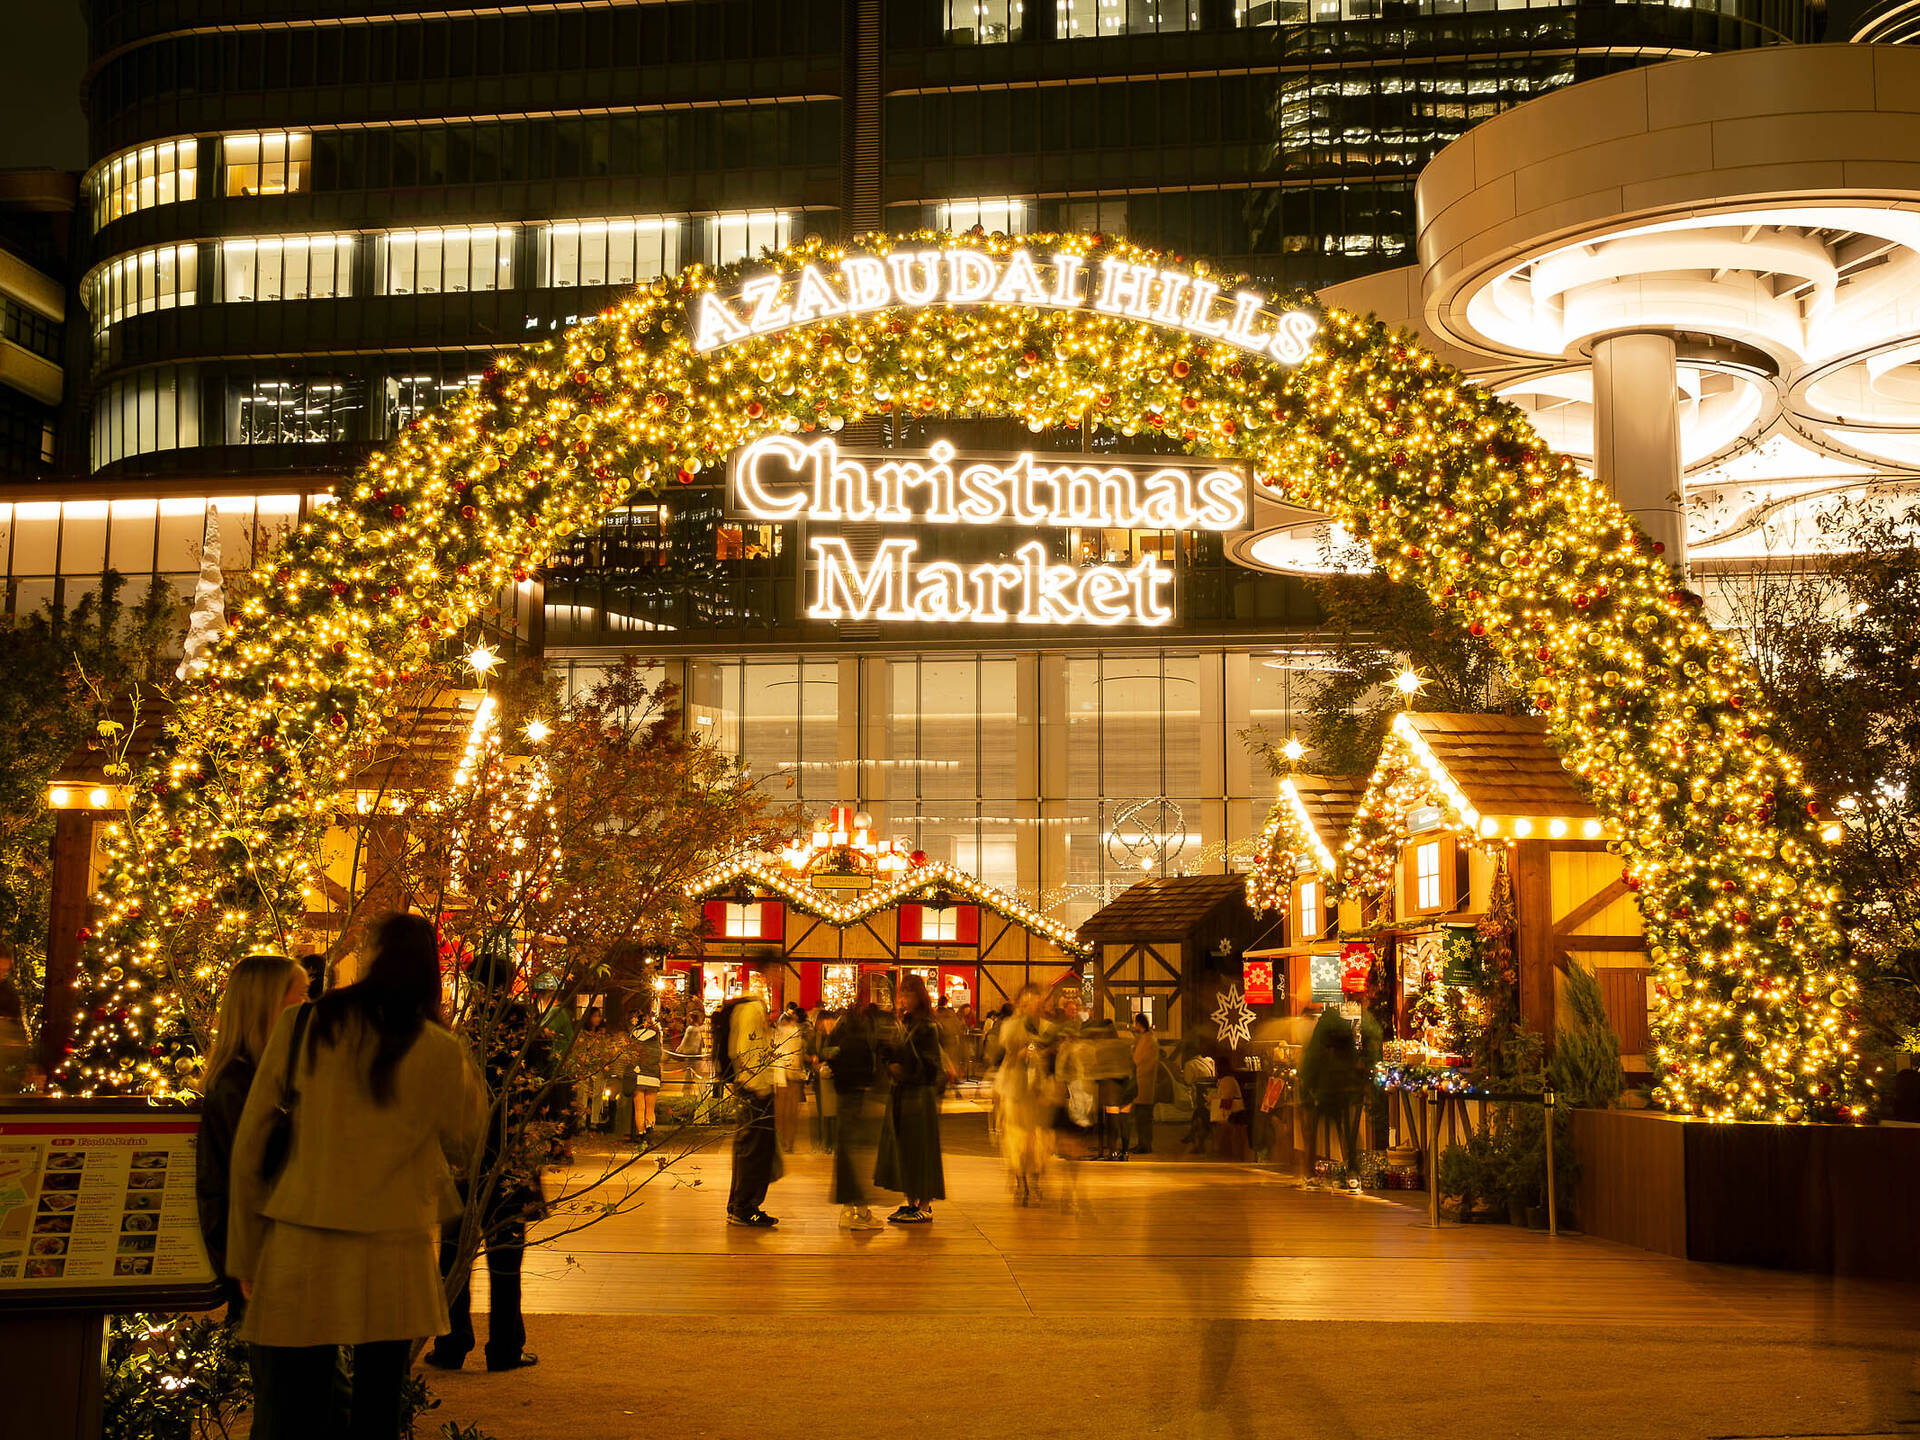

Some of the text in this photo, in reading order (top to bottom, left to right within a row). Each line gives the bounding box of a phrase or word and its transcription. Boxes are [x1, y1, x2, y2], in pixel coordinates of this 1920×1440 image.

[696, 249, 1319, 366] AZABUDAI HILLS
[735, 436, 1247, 530] Christmas
[807, 536, 1174, 627] Market
